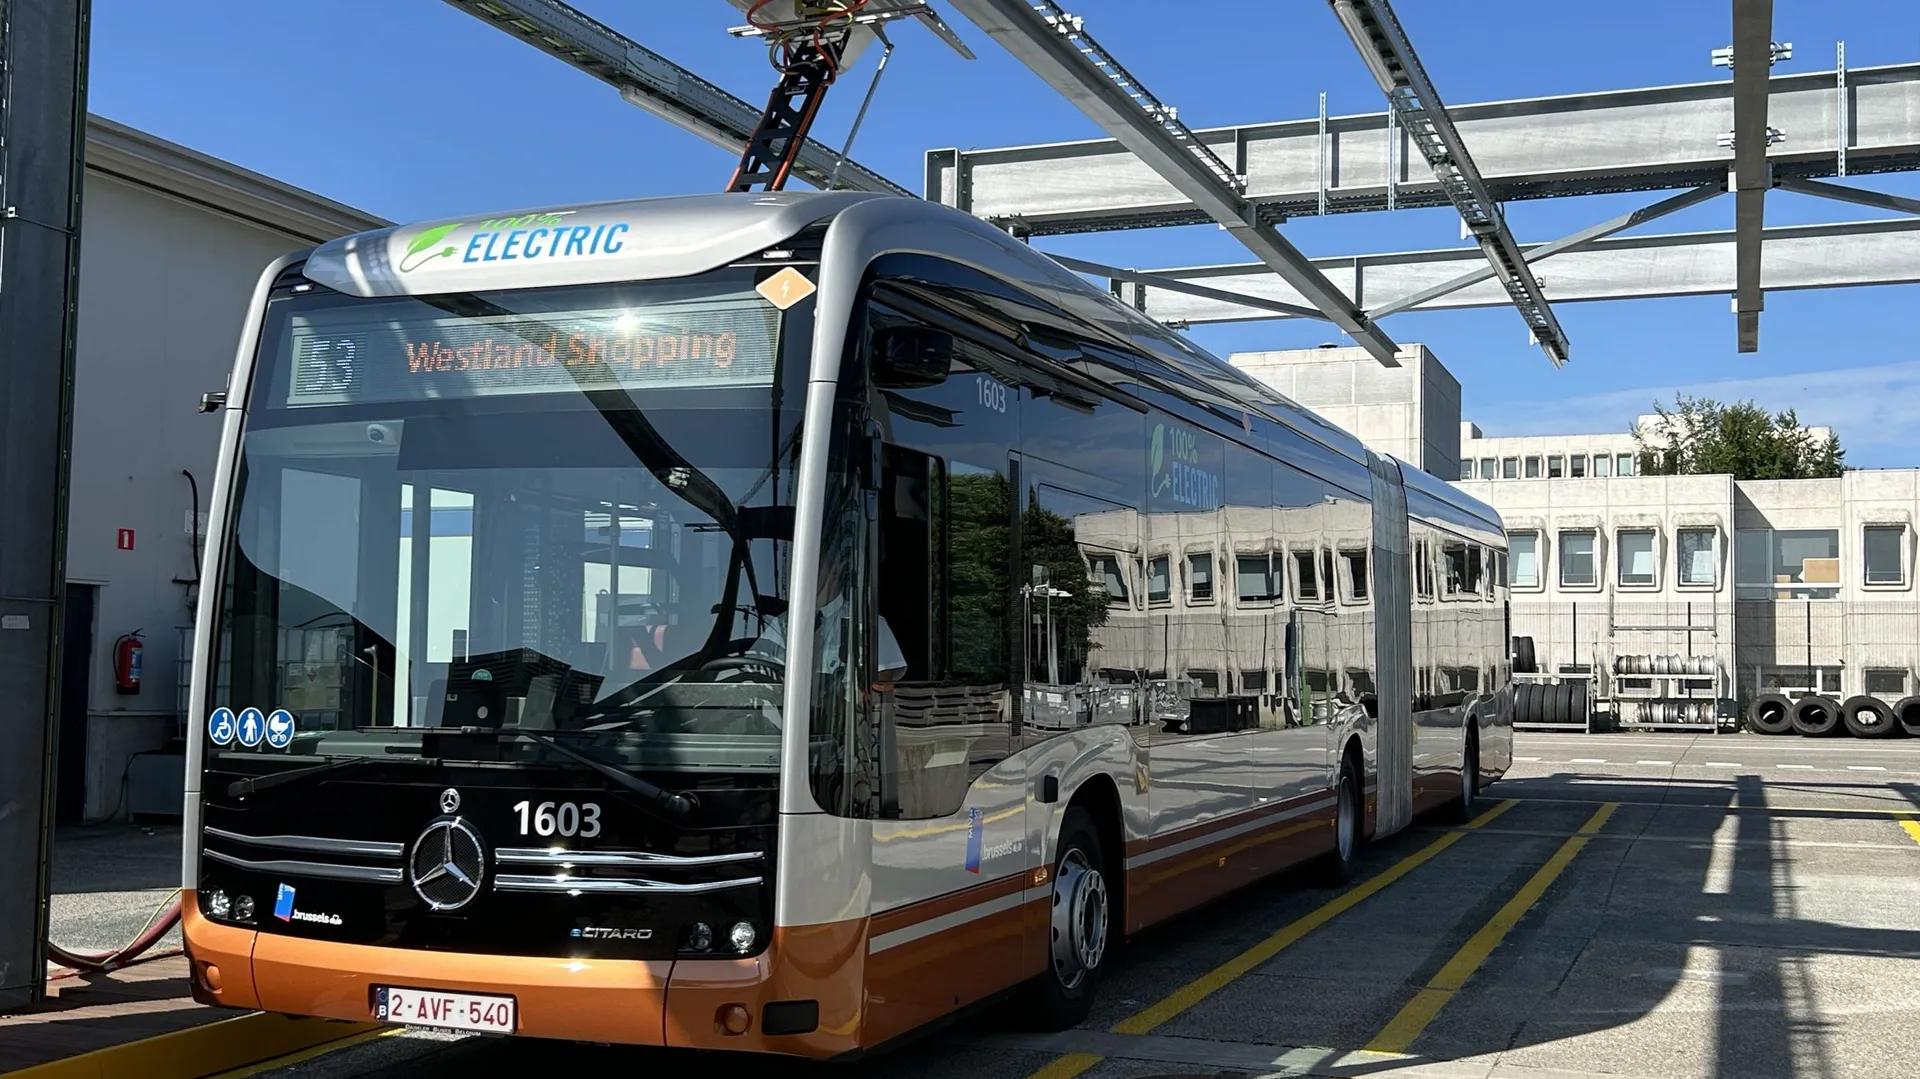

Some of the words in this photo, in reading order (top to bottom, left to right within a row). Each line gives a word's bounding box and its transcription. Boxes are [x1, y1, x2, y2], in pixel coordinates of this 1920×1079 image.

[479, 214, 563, 231] 100%
[463, 223, 629, 263] ELECTRIC
[306, 339, 356, 391] 53
[407, 332, 557, 373] Westland
[566, 329, 737, 370] Shopping
[976, 376, 1006, 413] 1603
[1169, 426, 1198, 465] 100%
[1172, 461, 1219, 511] ELECTRIC
[513, 800, 601, 838] 1603
[379, 1005, 387, 1016] B
